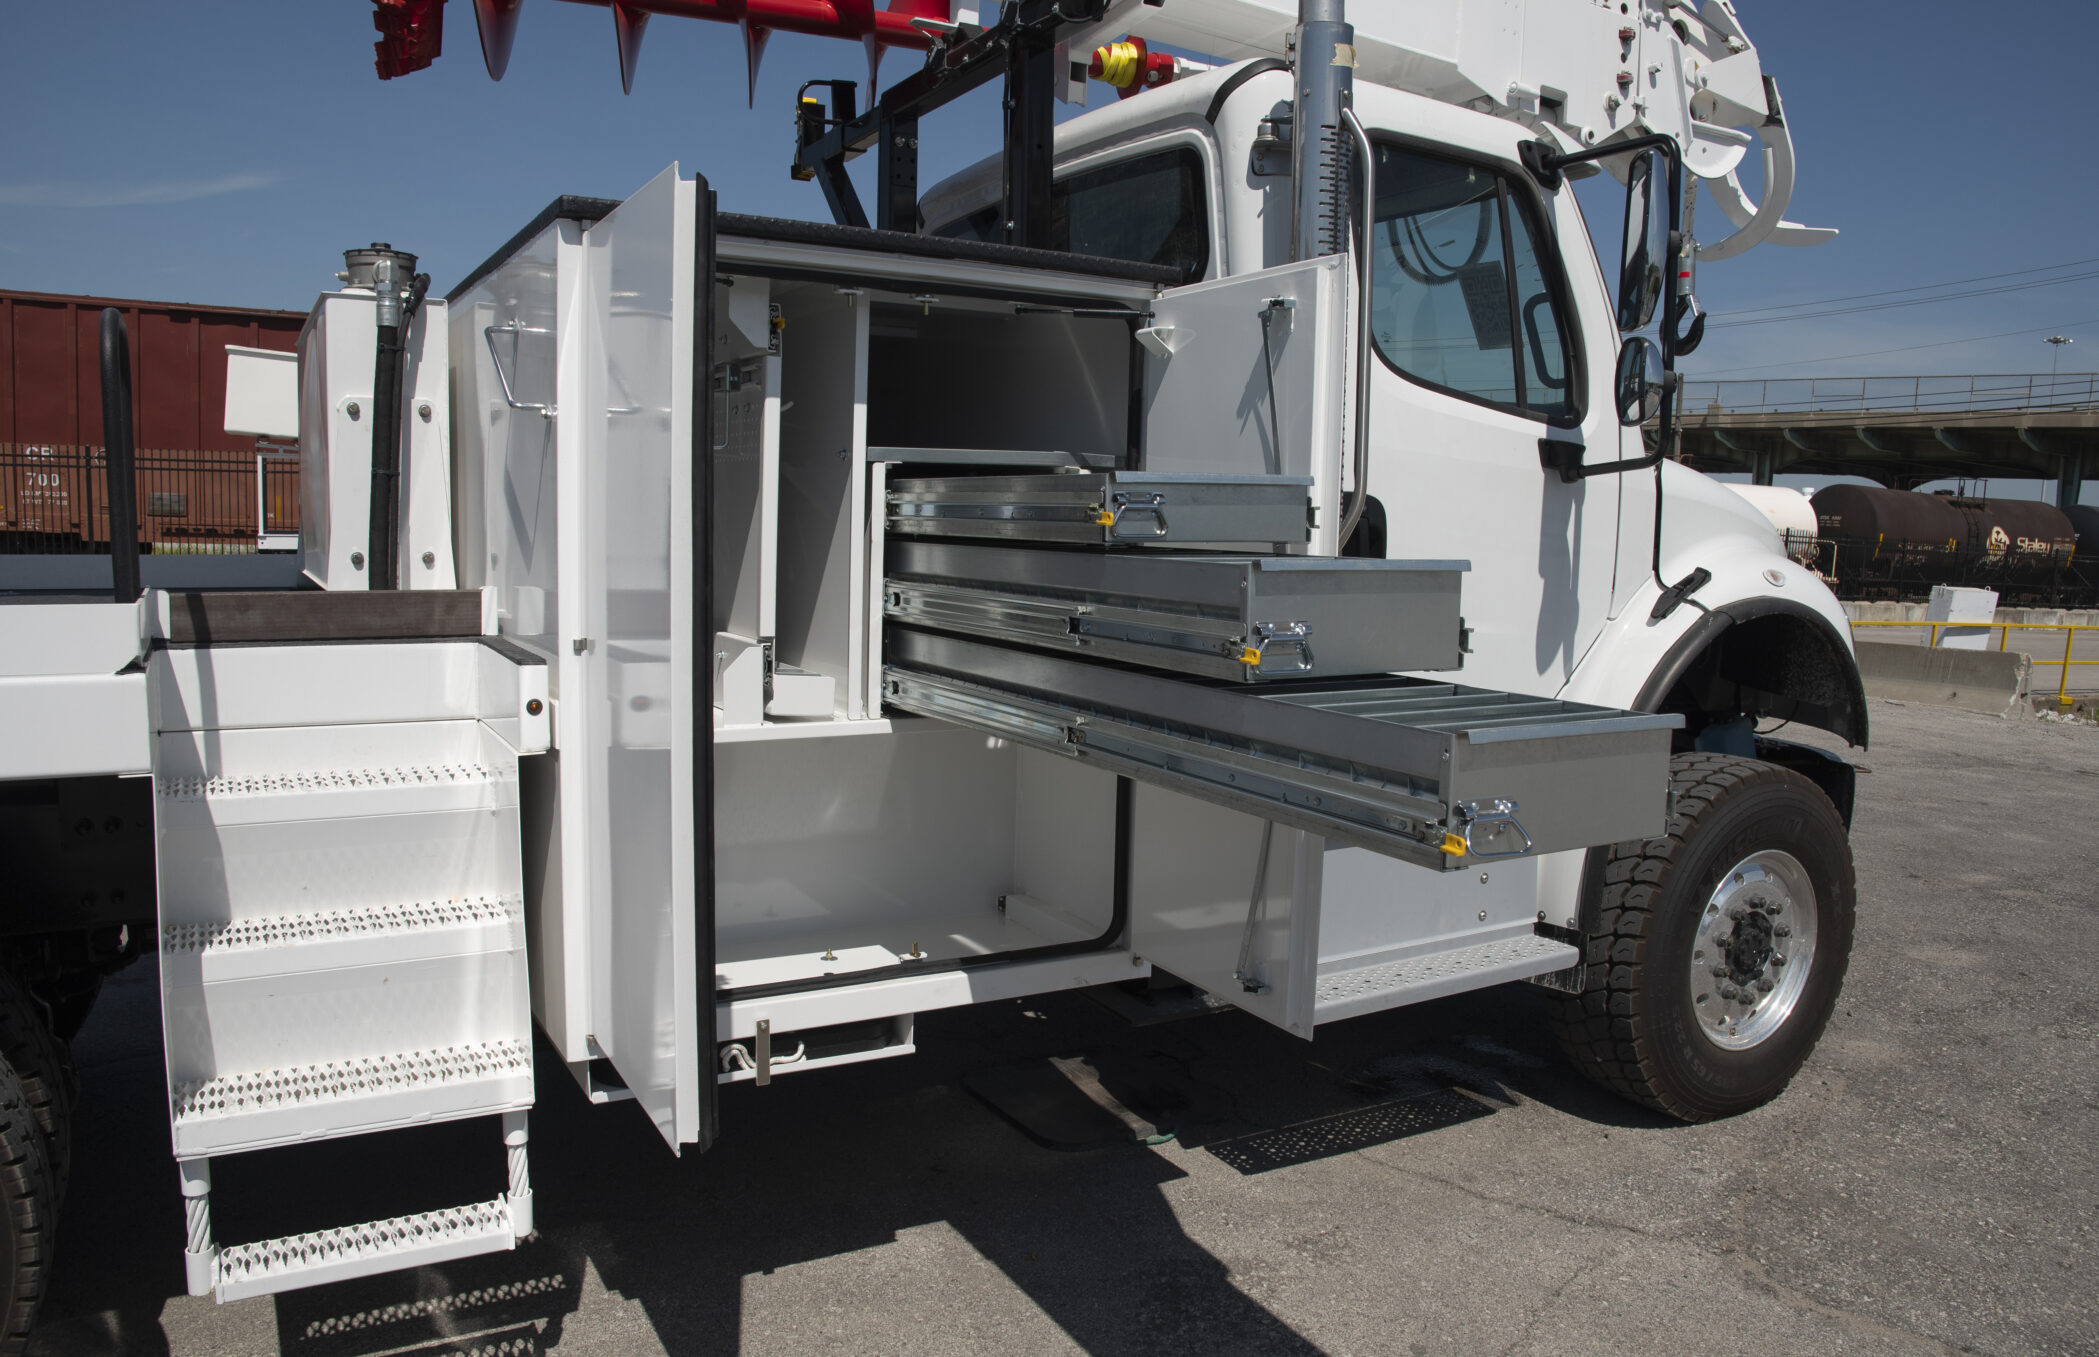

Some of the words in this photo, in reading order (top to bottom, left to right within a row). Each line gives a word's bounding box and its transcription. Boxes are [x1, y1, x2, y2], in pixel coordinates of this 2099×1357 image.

[26, 446, 54, 461] CR
[26, 472, 60, 487] 700
[2016, 536, 2051, 558] Staley
